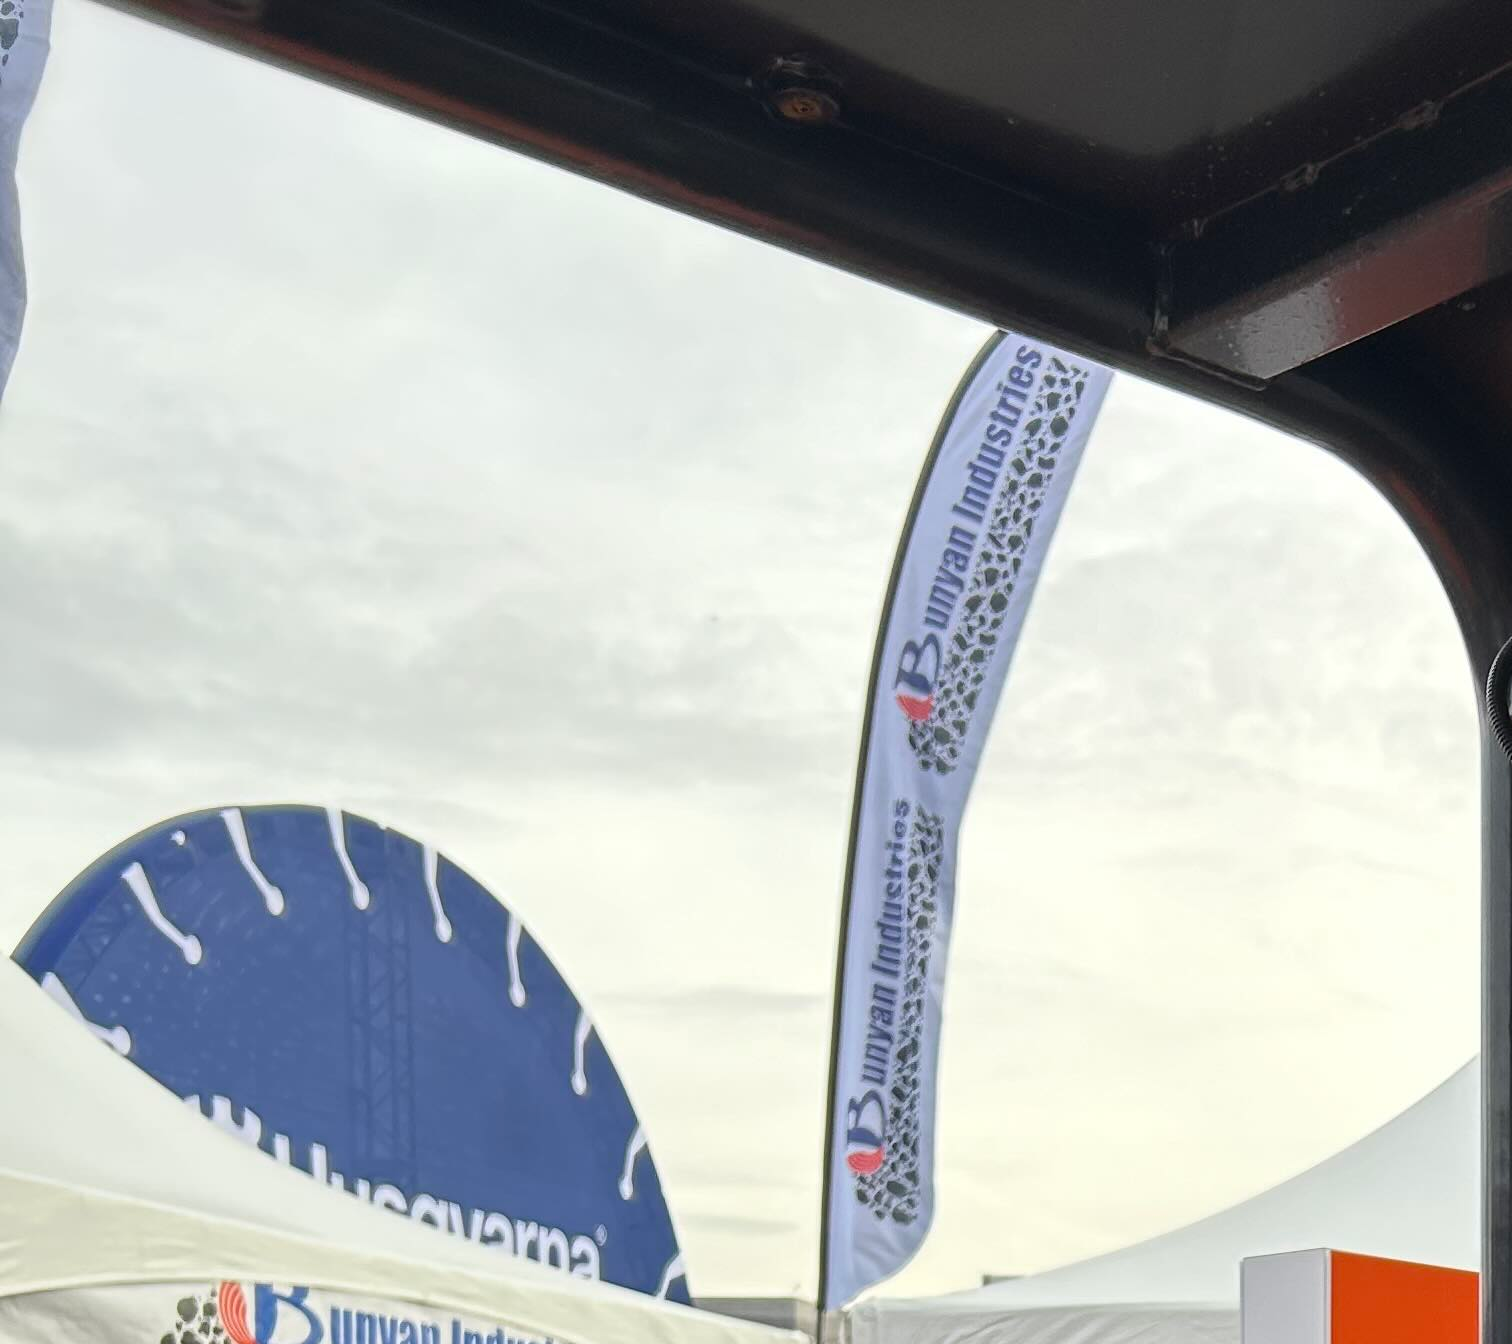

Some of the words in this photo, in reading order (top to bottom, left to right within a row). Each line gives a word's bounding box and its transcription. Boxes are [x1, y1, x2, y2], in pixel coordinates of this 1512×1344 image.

[894, 524, 979, 690] Bunyan
[951, 344, 1043, 525] Industries
[871, 797, 912, 980] Industries
[846, 982, 899, 1147] Bunyan
